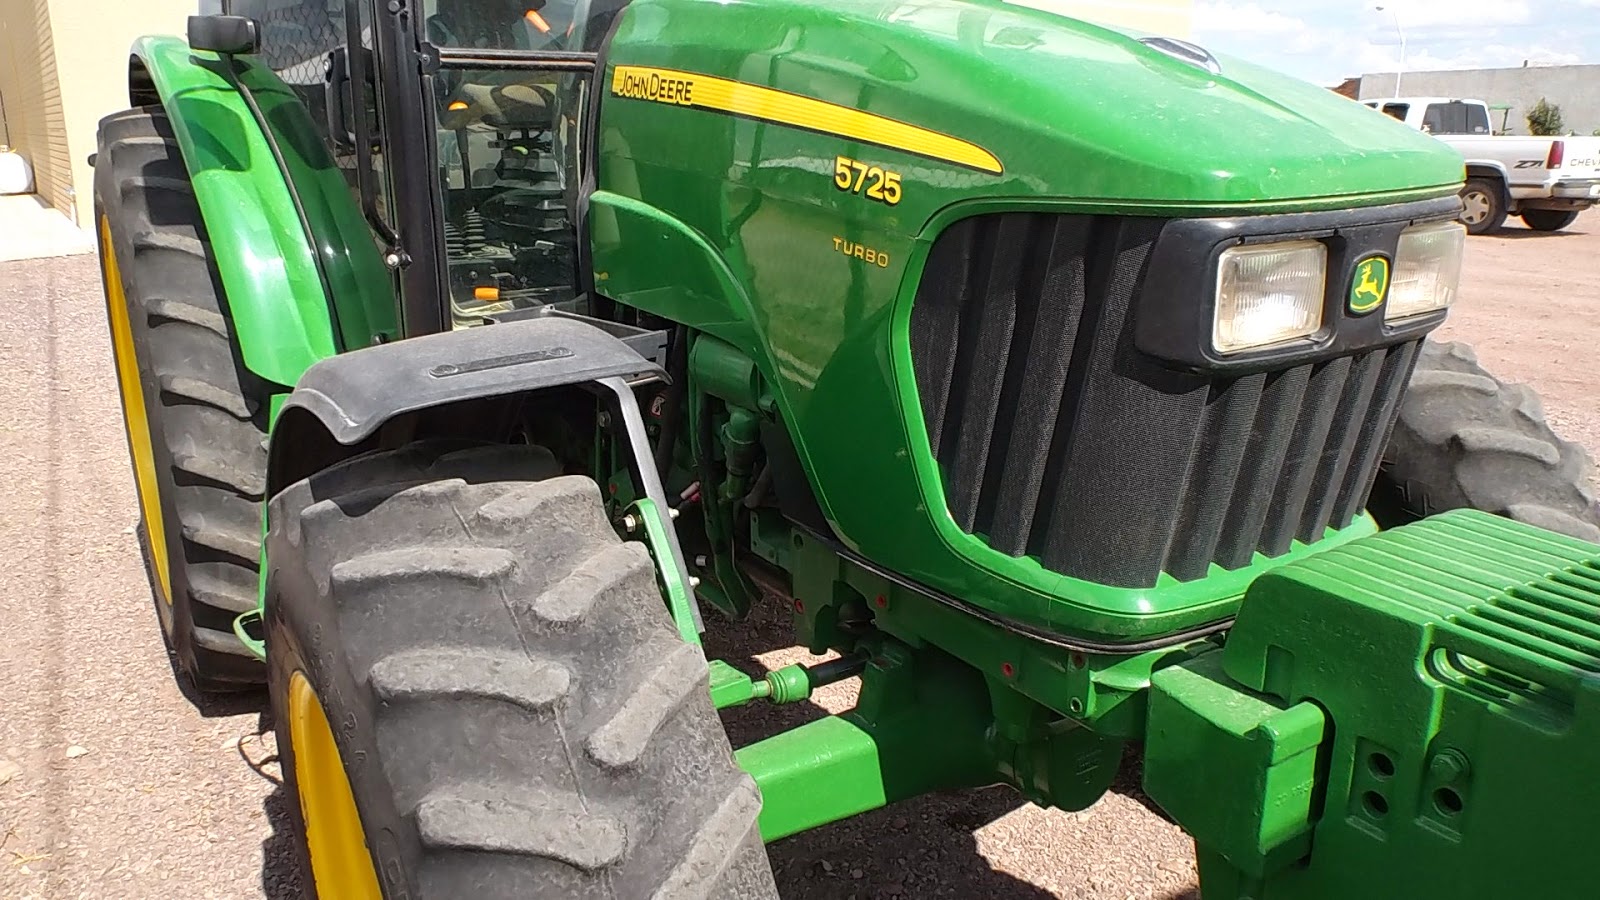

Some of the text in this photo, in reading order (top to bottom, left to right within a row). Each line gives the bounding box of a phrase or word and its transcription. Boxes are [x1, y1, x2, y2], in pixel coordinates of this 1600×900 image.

[620, 71, 693, 102] JOHN DEERE
[1570, 158, 1600, 167] CHEV
[834, 155, 902, 206] 5725
[832, 236, 889, 268] TURBO
